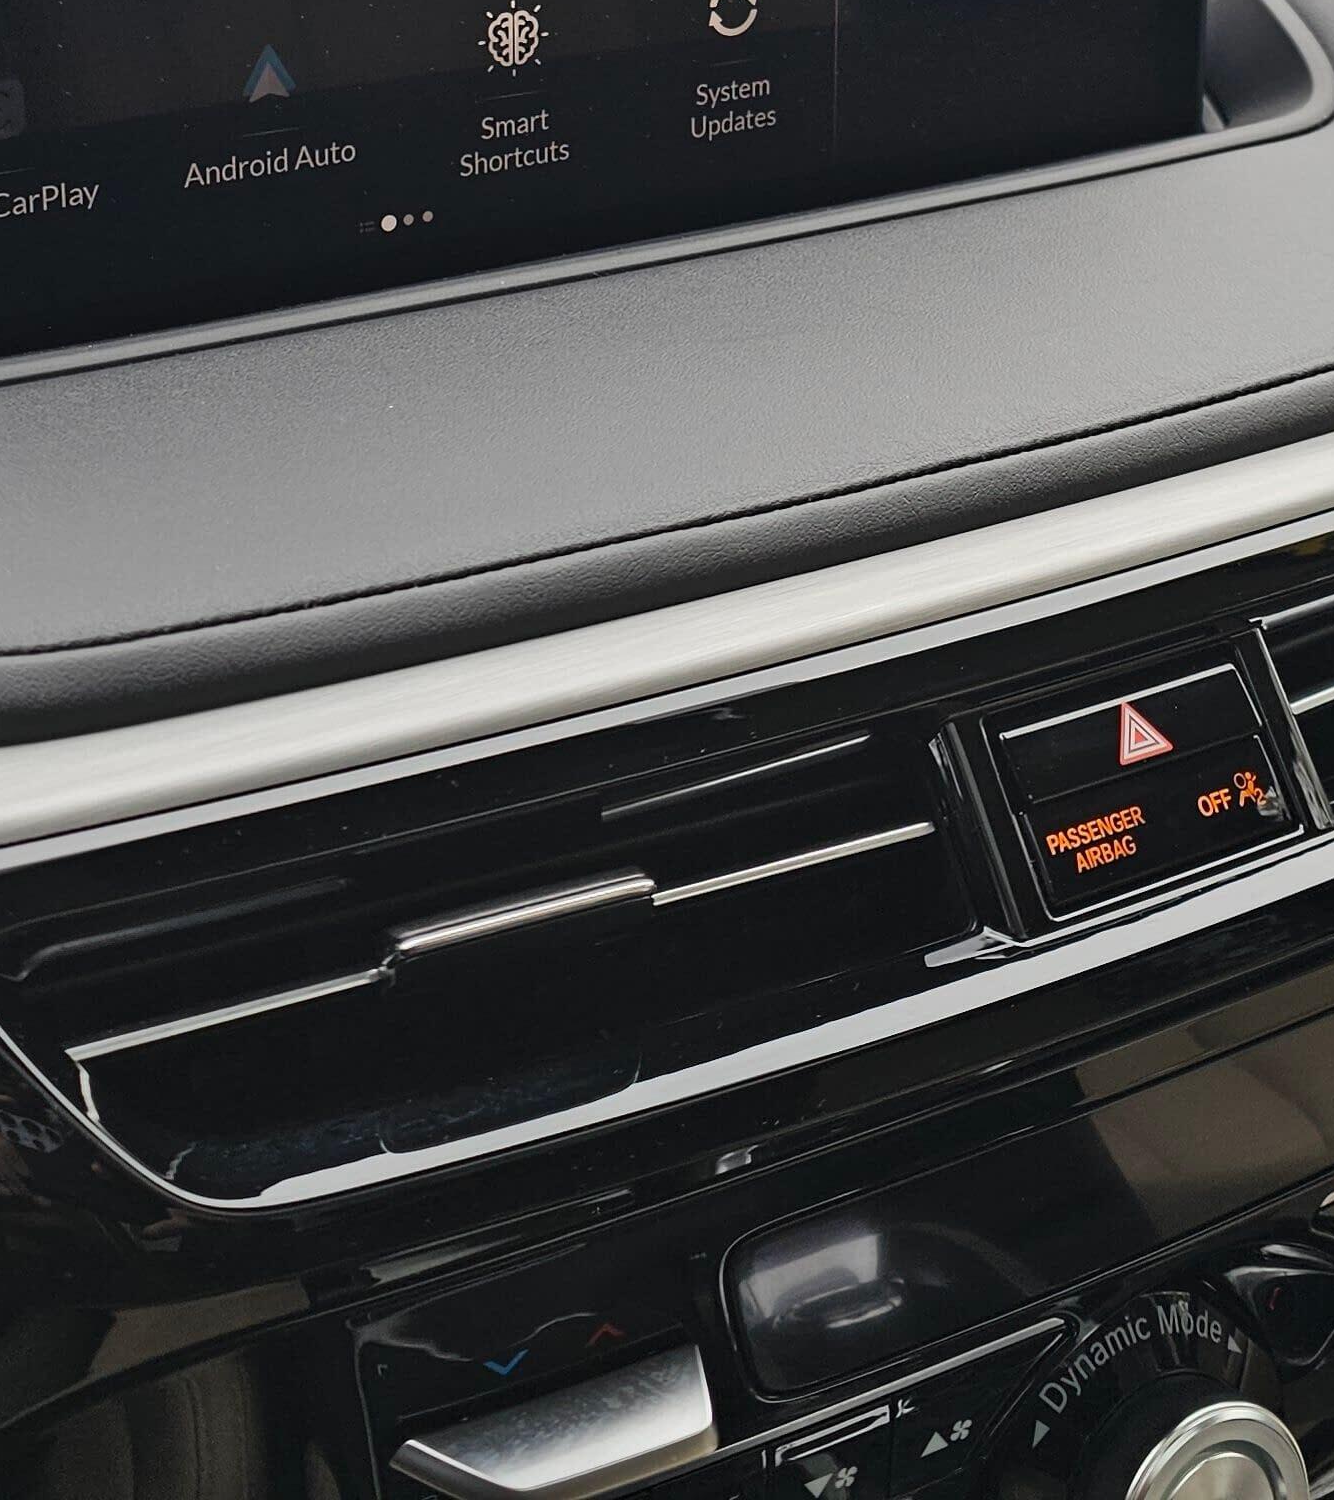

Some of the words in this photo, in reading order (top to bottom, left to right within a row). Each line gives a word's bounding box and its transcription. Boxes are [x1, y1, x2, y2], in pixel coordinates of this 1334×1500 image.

[696, 78, 771, 110] System
[481, 108, 550, 140] Smart
[689, 107, 777, 142] Updates
[184, 147, 289, 189] Android
[294, 141, 357, 171] Auto
[459, 137, 570, 179] Shortcuts
[1198, 788, 1232, 817] OFF
[1046, 806, 1145, 856] PASSENGER
[1075, 835, 1137, 873] AIRBAG
[1038, 1313, 1151, 1414] Dynamic
[1158, 1303, 1223, 1344] Mode
